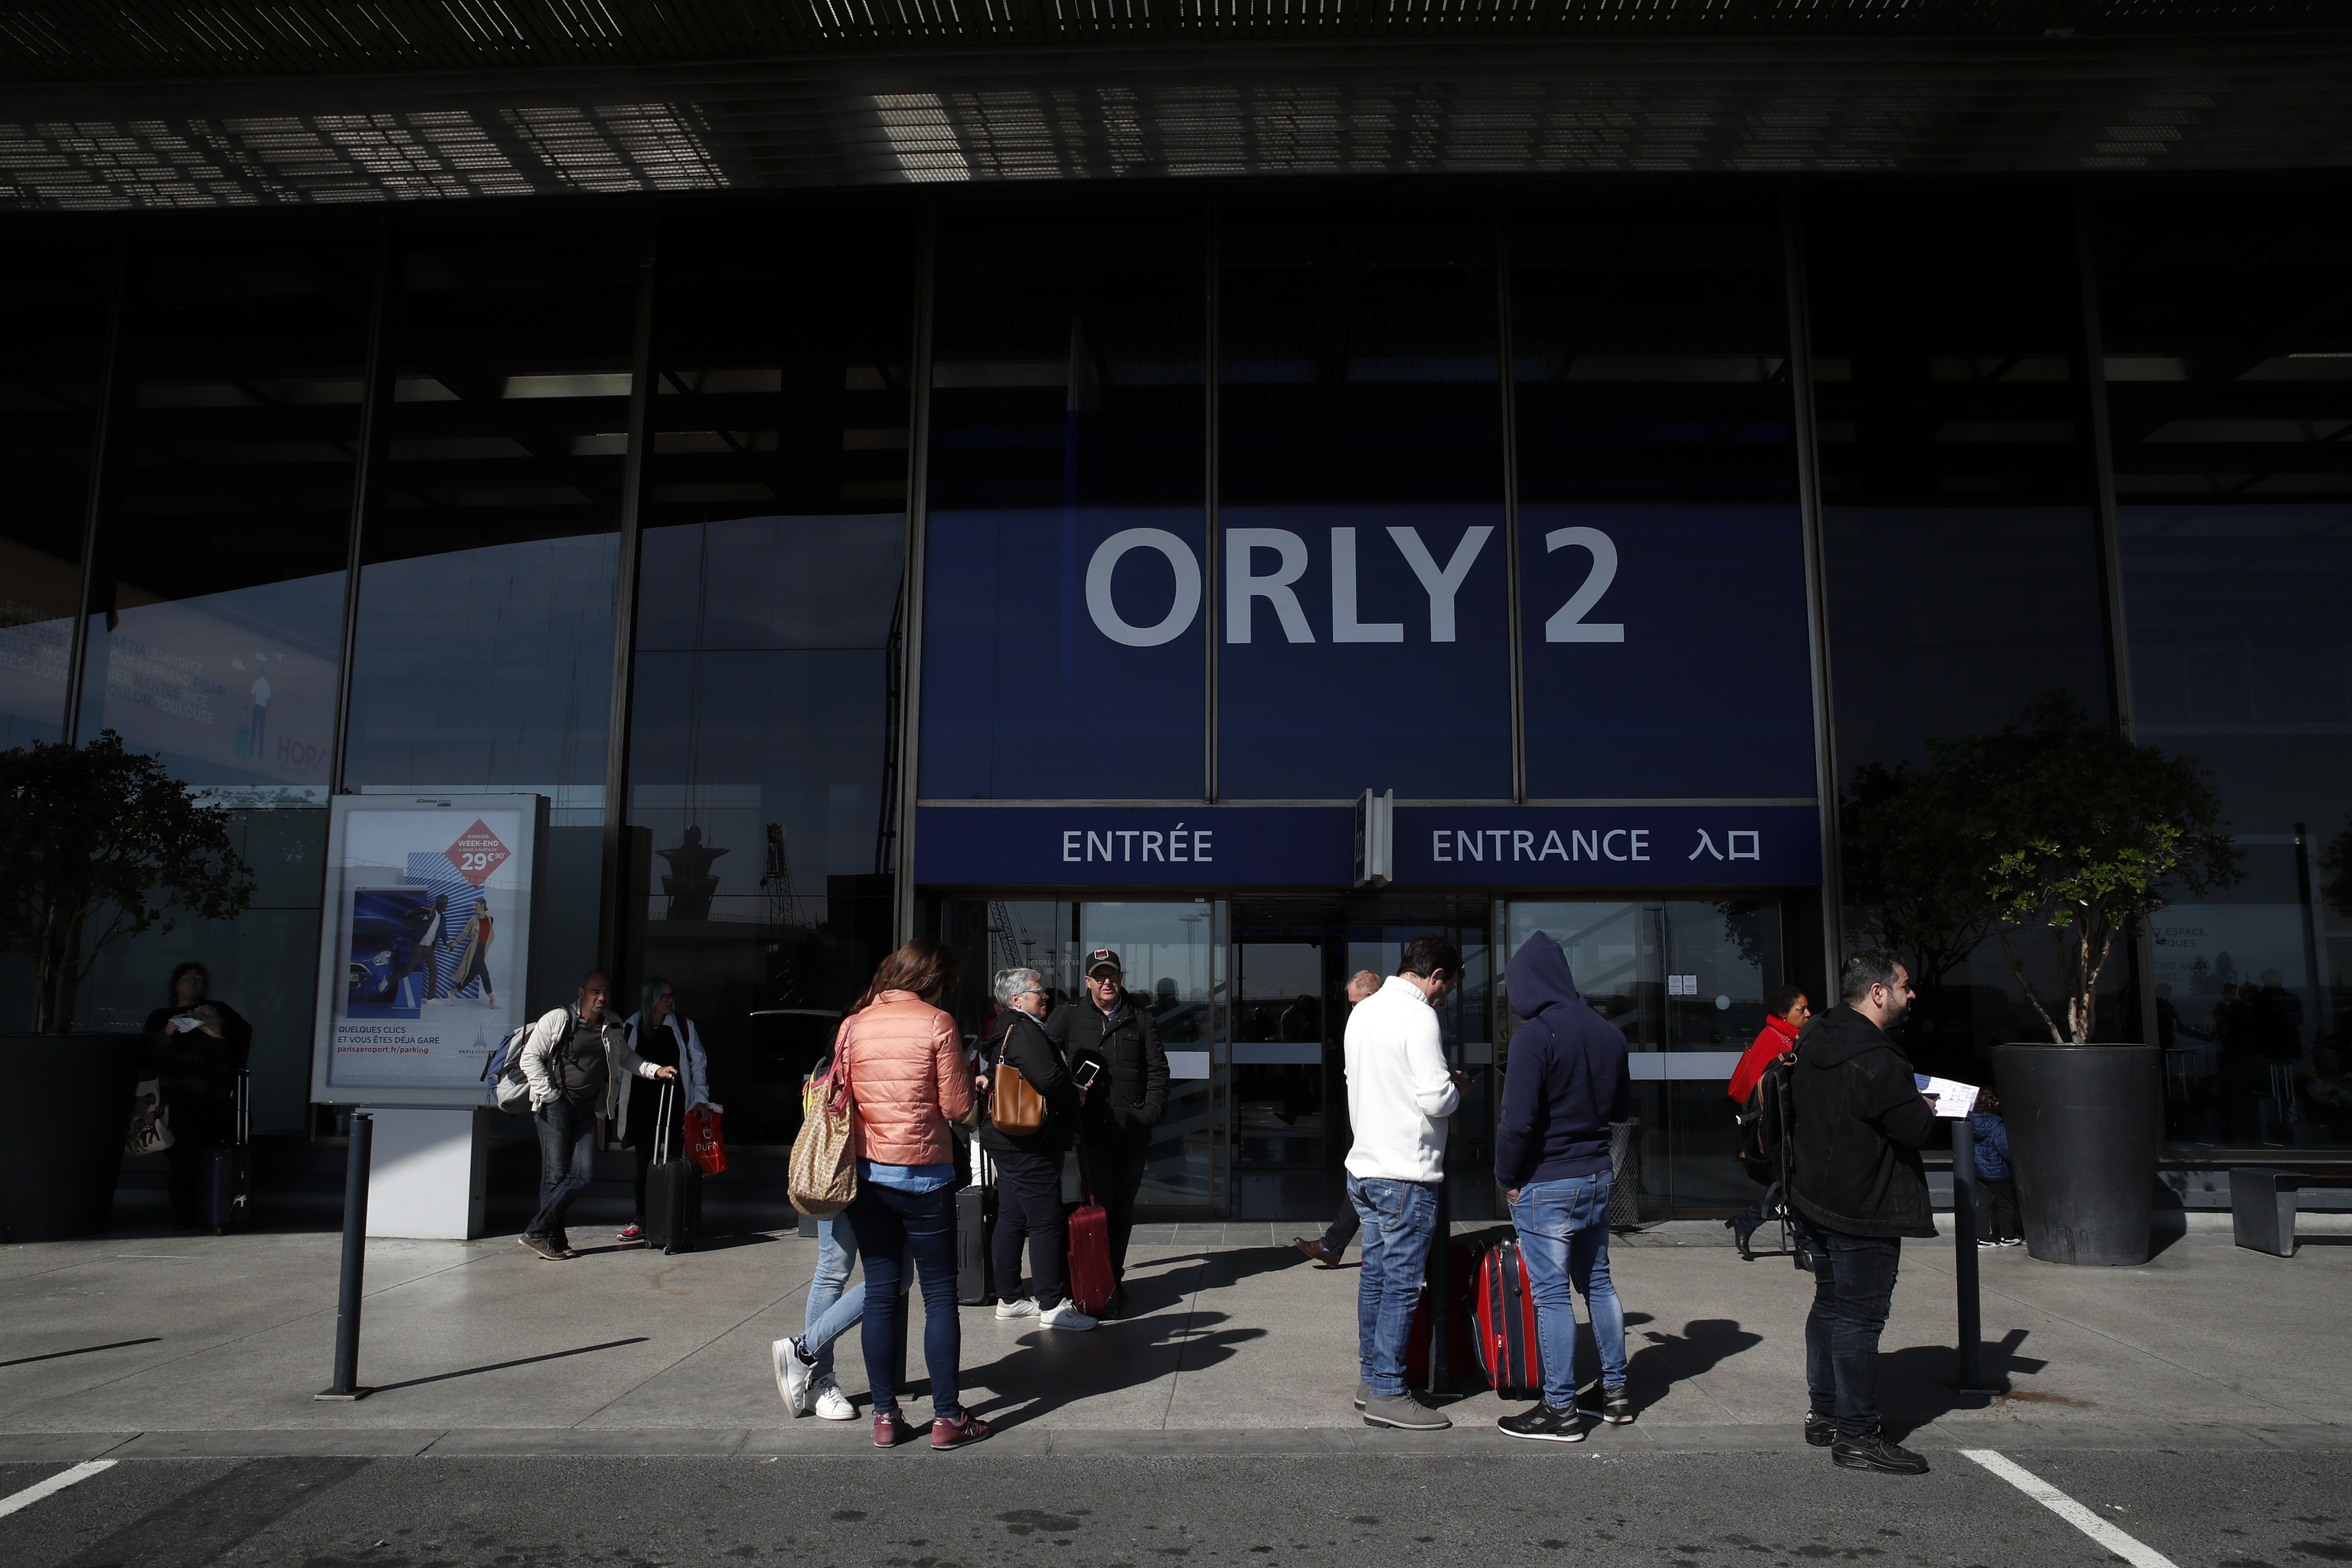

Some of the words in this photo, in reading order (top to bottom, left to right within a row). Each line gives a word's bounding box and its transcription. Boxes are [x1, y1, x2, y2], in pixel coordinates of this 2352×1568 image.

[1085, 525, 1494, 646] ORLY
[1545, 526, 1624, 642] 2
[2, 616, 64, 647] CASTRES
[109, 651, 191, 687] ONT-FERRAND
[193, 678, 227, 698] FIGARI
[150, 647, 203, 675] BIARRITZ
[134, 675, 180, 699] NANTES
[182, 689, 208, 707] NICE
[155, 695, 214, 724] TOULOUSE
[276, 736, 327, 769] HOP!
[1063, 822, 1212, 861] ENTRÉE
[1433, 829, 1649, 861] ENTRANCE
[1688, 828, 1759, 861] 入口
[2165, 927, 2209, 936] ESPACE.
[2154, 962, 2176, 971] THIS
[338, 1026, 382, 1034] QUELQUES
[373, 1034, 393, 1044] ÊTES
[394, 1034, 416, 1044] DÉJÀ
[417, 1034, 440, 1044] GARÉ
[337, 1046, 429, 1055] parisaeroport.fr/parking
